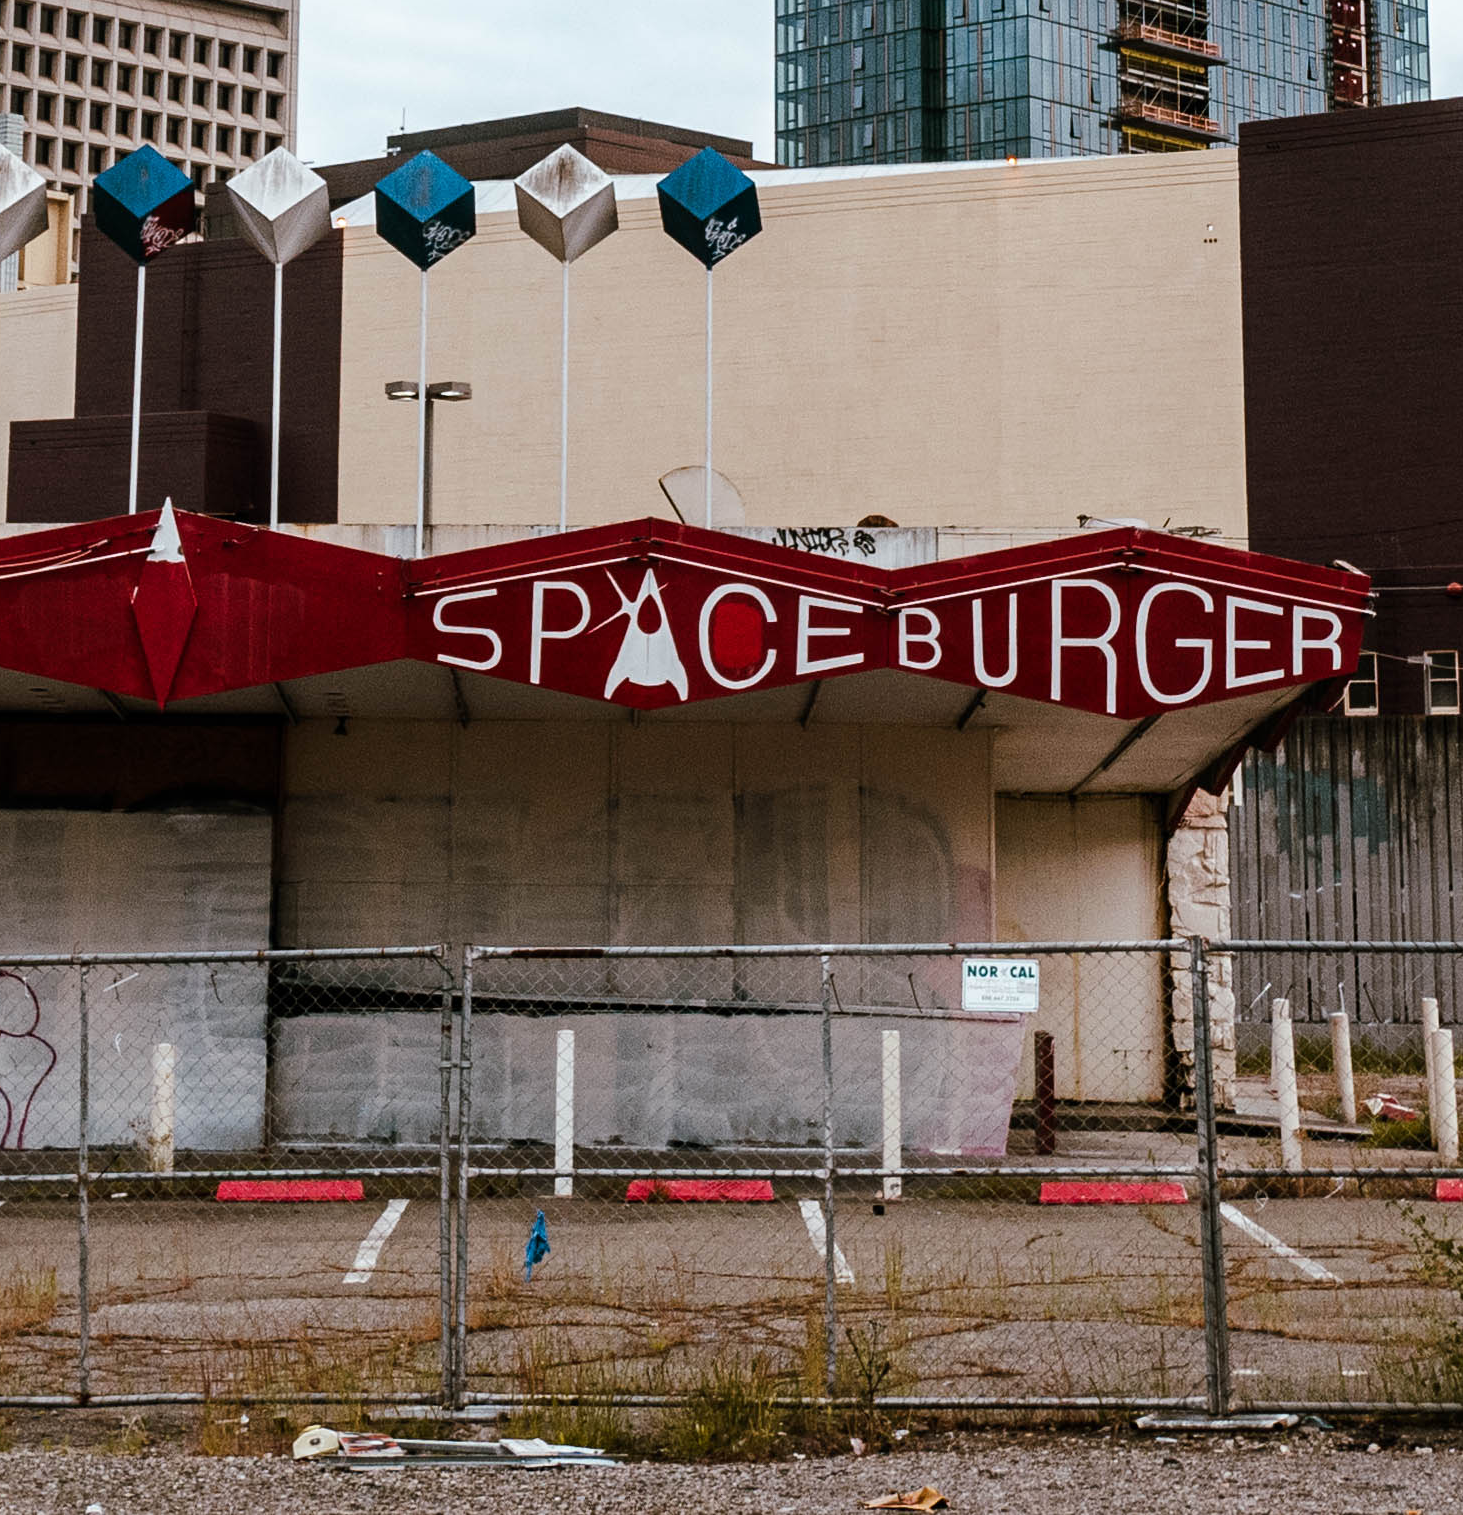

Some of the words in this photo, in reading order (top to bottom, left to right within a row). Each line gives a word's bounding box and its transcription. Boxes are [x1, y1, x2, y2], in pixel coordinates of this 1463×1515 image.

[432, 566, 866, 702] SPACE
[898, 577, 1342, 715] BURGER
[967, 966, 998, 977] NOR
[1010, 966, 1035, 978] CAL
